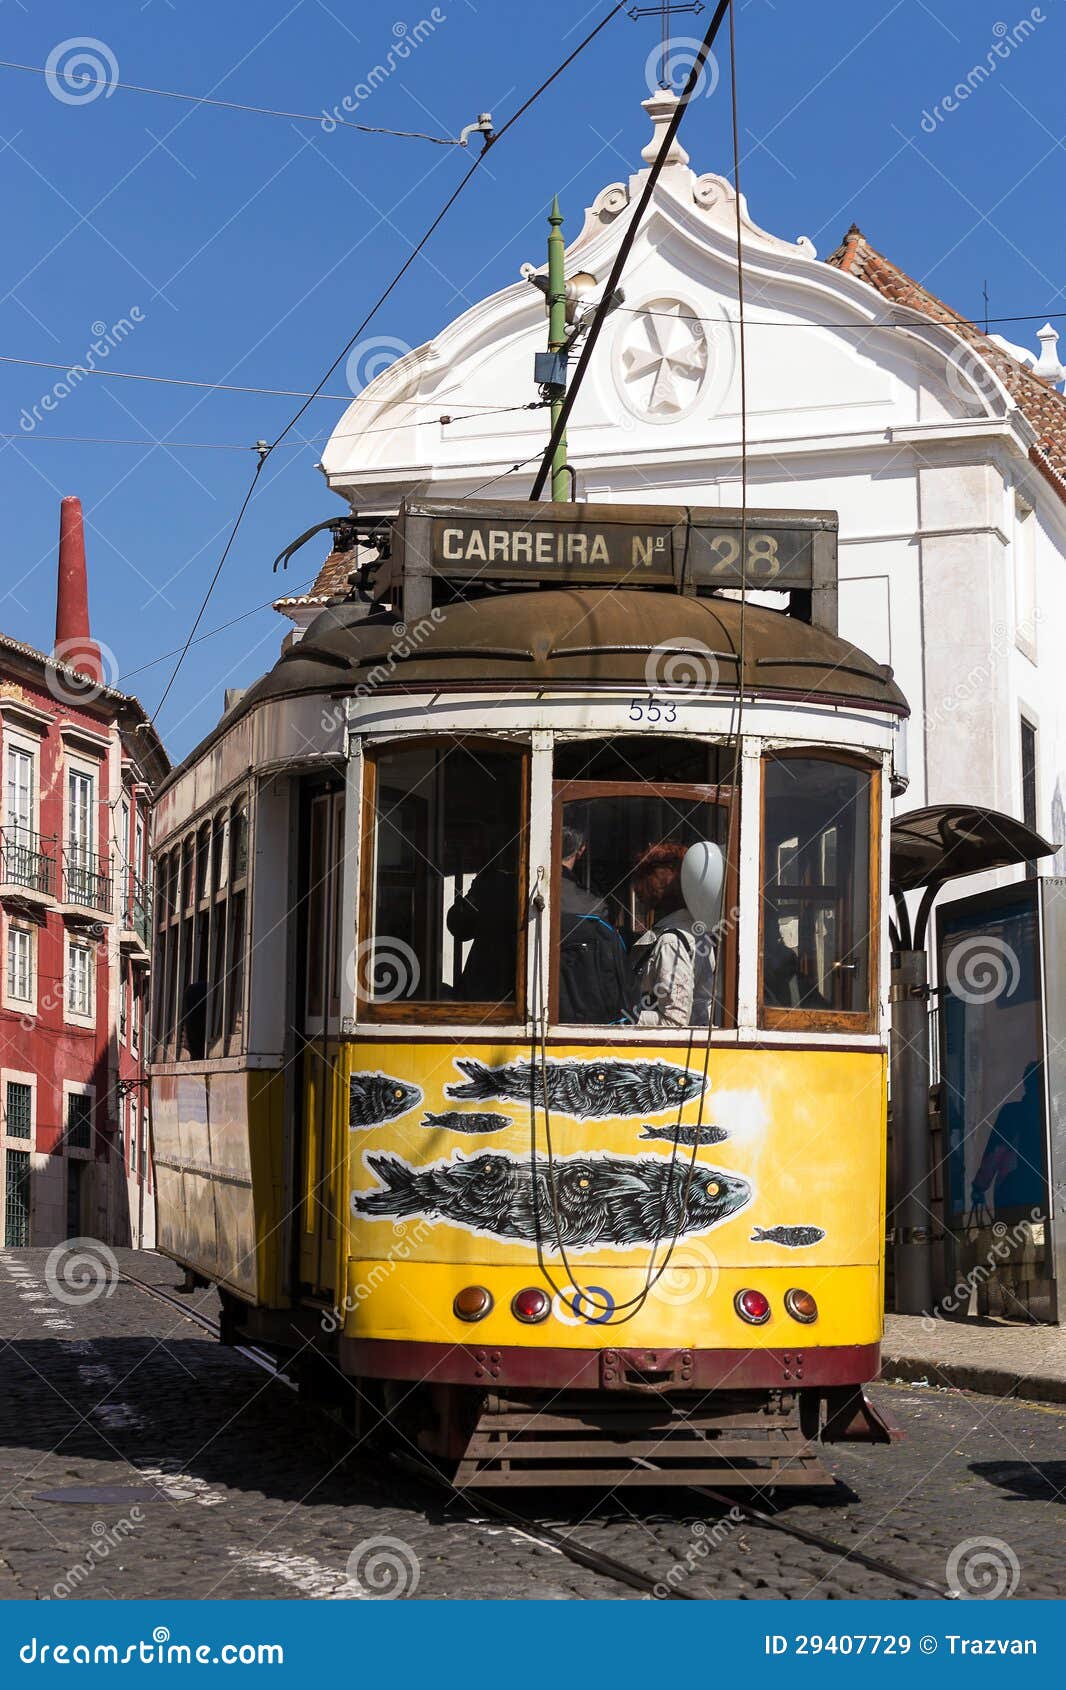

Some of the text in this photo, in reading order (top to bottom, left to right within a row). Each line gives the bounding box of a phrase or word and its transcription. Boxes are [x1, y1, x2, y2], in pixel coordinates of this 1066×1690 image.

[442, 528, 611, 566] CARREIRA
[709, 534, 780, 577] 28
[628, 698, 677, 722] 553
